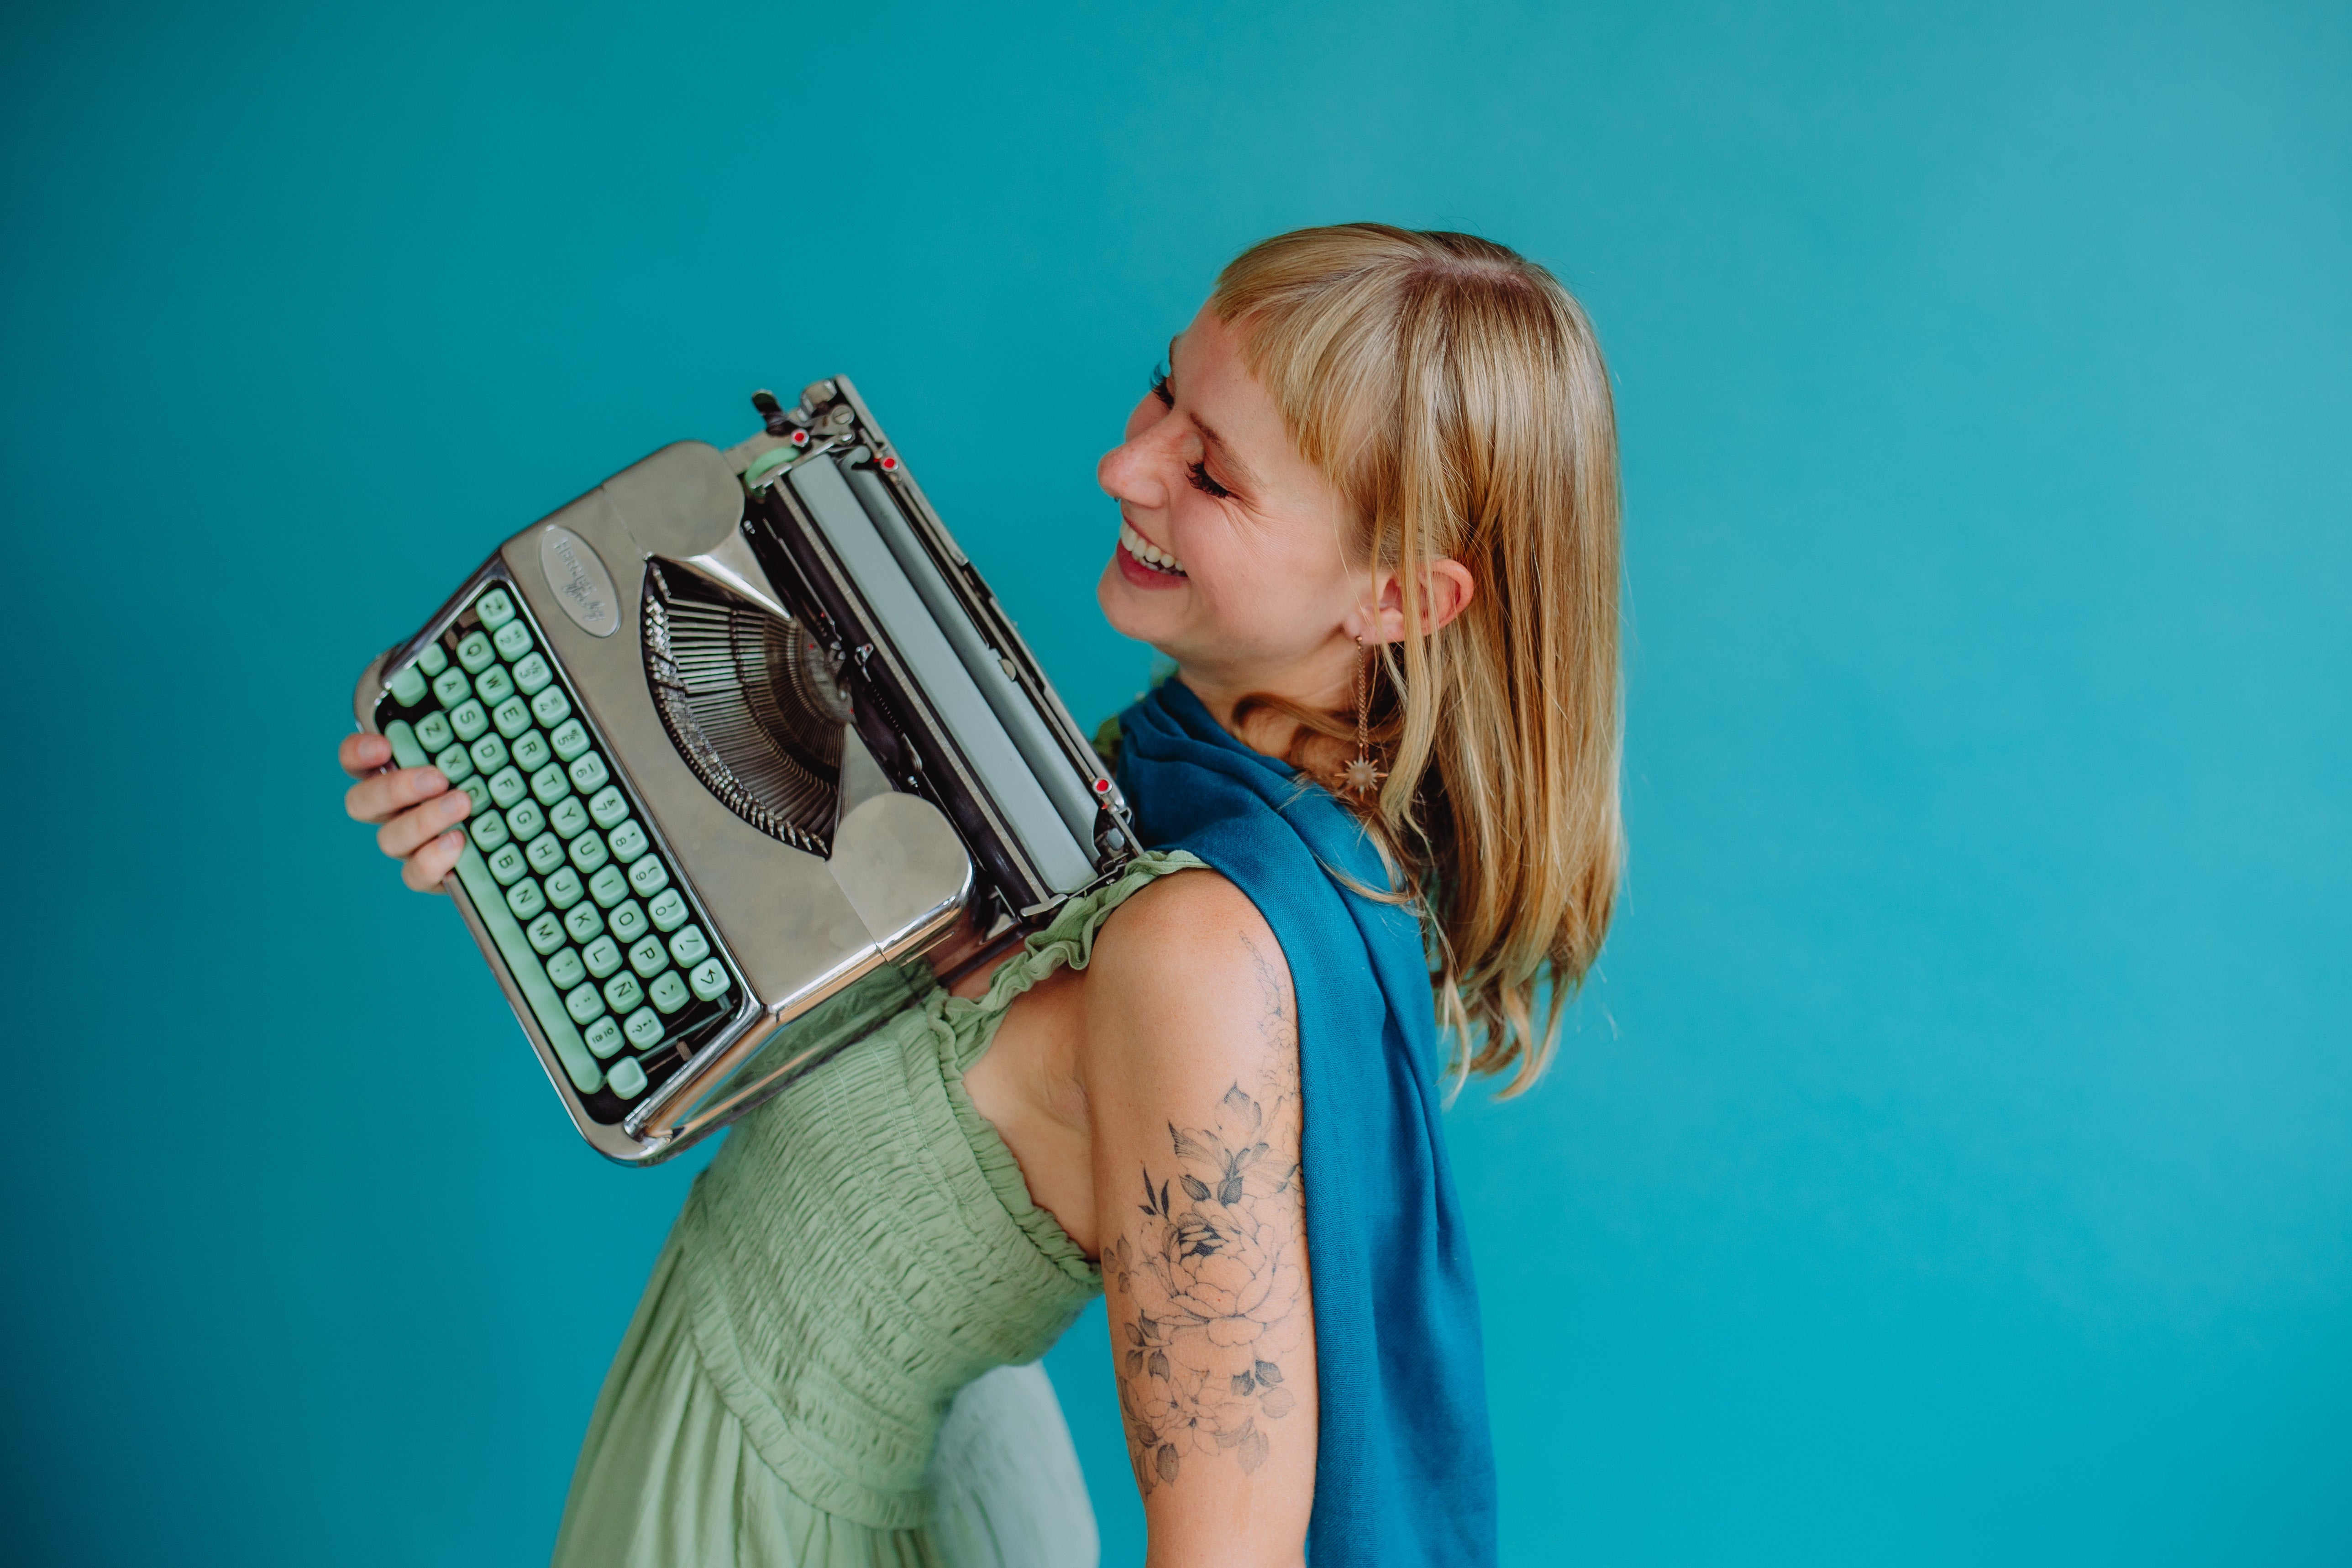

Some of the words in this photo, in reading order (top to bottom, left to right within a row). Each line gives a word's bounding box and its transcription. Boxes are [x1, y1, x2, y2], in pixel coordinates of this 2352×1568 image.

[552, 538, 595, 598] HERMES
[425, 722, 441, 736] Z
[446, 755, 461, 768] X
[482, 821, 496, 833] V
[498, 854, 514, 869] B
[516, 888, 532, 904] N
[536, 923, 554, 940] M
[442, 681, 457, 693] A
[459, 709, 476, 724] S
[480, 743, 496, 758] D
[498, 777, 514, 787] F
[516, 810, 532, 824] G
[536, 843, 552, 859] H
[555, 881, 570, 892] J
[574, 912, 590, 928] K
[593, 947, 605, 963] L
[614, 981, 633, 998] Ñ
[466, 643, 482, 656] Q
[485, 675, 501, 689] W
[502, 706, 519, 721] E
[522, 741, 537, 756] R
[542, 774, 557, 786] T
[562, 807, 576, 819] Y
[579, 841, 595, 855] U
[600, 879, 614, 888] I
[619, 912, 634, 926] O
[639, 947, 655, 959] P
[499, 635, 511, 645] 2
[518, 668, 531, 679] 3
[539, 703, 549, 712] 4
[557, 735, 569, 746] 5
[576, 768, 587, 778] 6
[595, 802, 608, 811] 7
[615, 837, 626, 847] 8
[635, 871, 646, 881] 9
[655, 906, 667, 916] 0
[648, 865, 657, 874] (
[632, 1024, 642, 1033] ?
